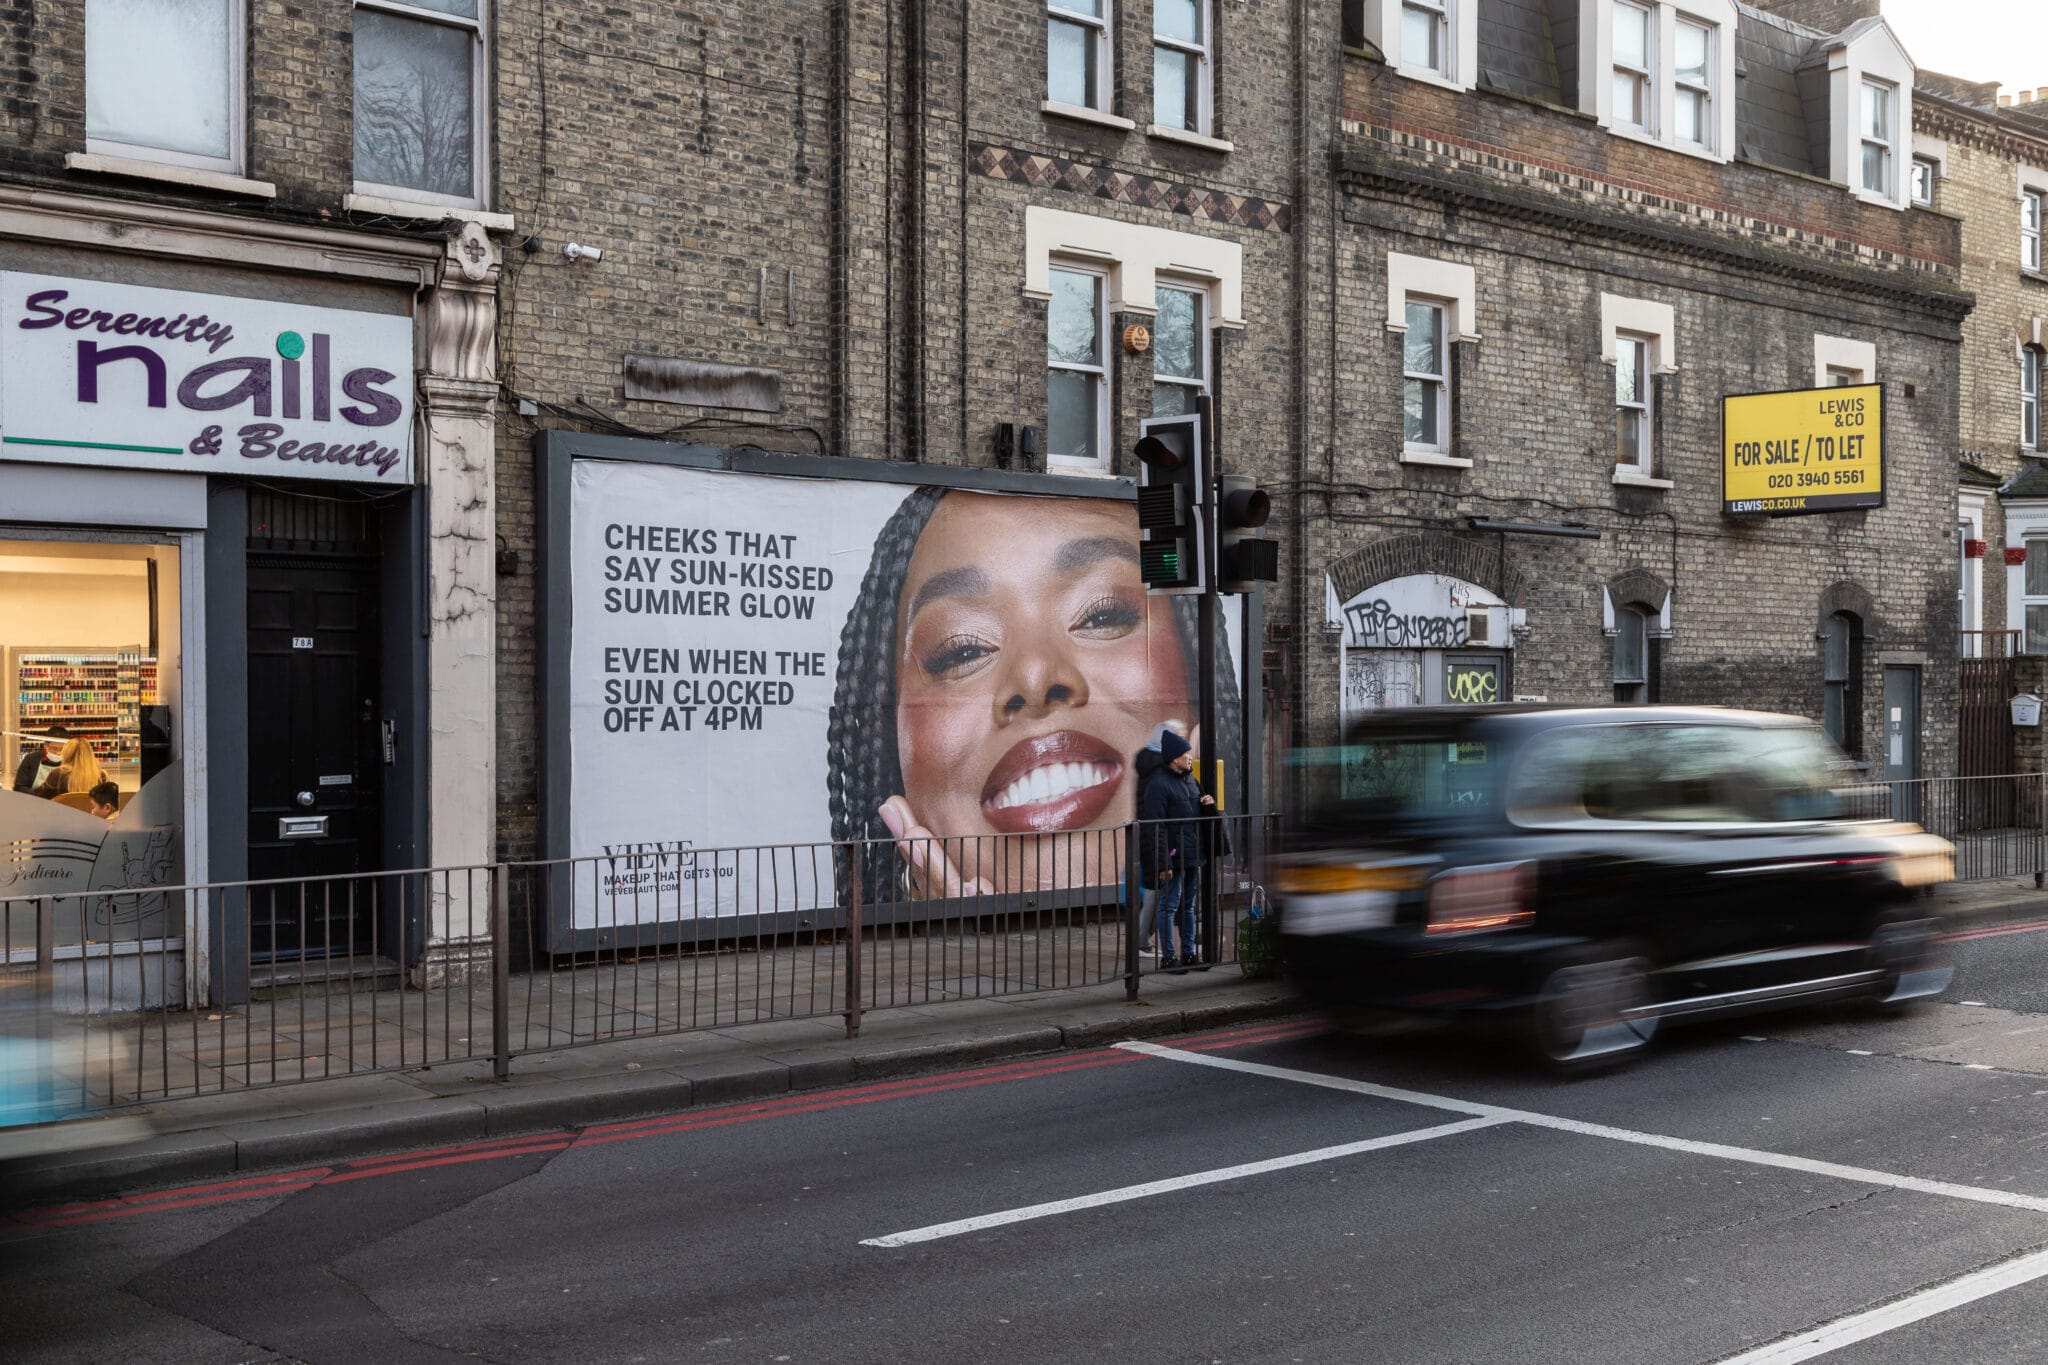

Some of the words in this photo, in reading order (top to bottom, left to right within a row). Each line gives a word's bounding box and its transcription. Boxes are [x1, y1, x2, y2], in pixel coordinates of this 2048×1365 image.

[19, 289, 234, 353] Serenity
[77, 330, 402, 427] nails
[1819, 397, 1865, 414] LEWIS
[1834, 412, 1865, 428] &CO
[189, 424, 223, 455] &
[237, 422, 401, 476] Beauty
[1734, 441, 1761, 467] FOR
[1765, 438, 1799, 465] SALE
[1815, 436, 1835, 462] TO
[1839, 434, 1865, 460] LET
[1768, 473, 1793, 489] 020
[1796, 471, 1830, 487] 3940
[1834, 469, 1865, 485] 5561
[1732, 497, 1806, 512] LEWISCO.CO.UK
[604, 523, 718, 555] CHEEKS
[725, 530, 797, 560] THAT
[604, 555, 661, 583] SAY
[670, 558, 834, 591] SUN-KISSED
[604, 587, 730, 617] SUMMER
[740, 592, 815, 620] GLOW
[294, 638, 312, 647] 78A
[604, 647, 680, 674] EVEN
[688, 649, 767, 675] WHEN
[775, 651, 826, 676] THE
[604, 678, 664, 705] SUN
[673, 679, 794, 706] CLOCKED
[603, 706, 654, 733] OFF
[660, 706, 697, 732] AT
[704, 705, 763, 731] 4PM
[601, 840, 694, 871] VIEVE
